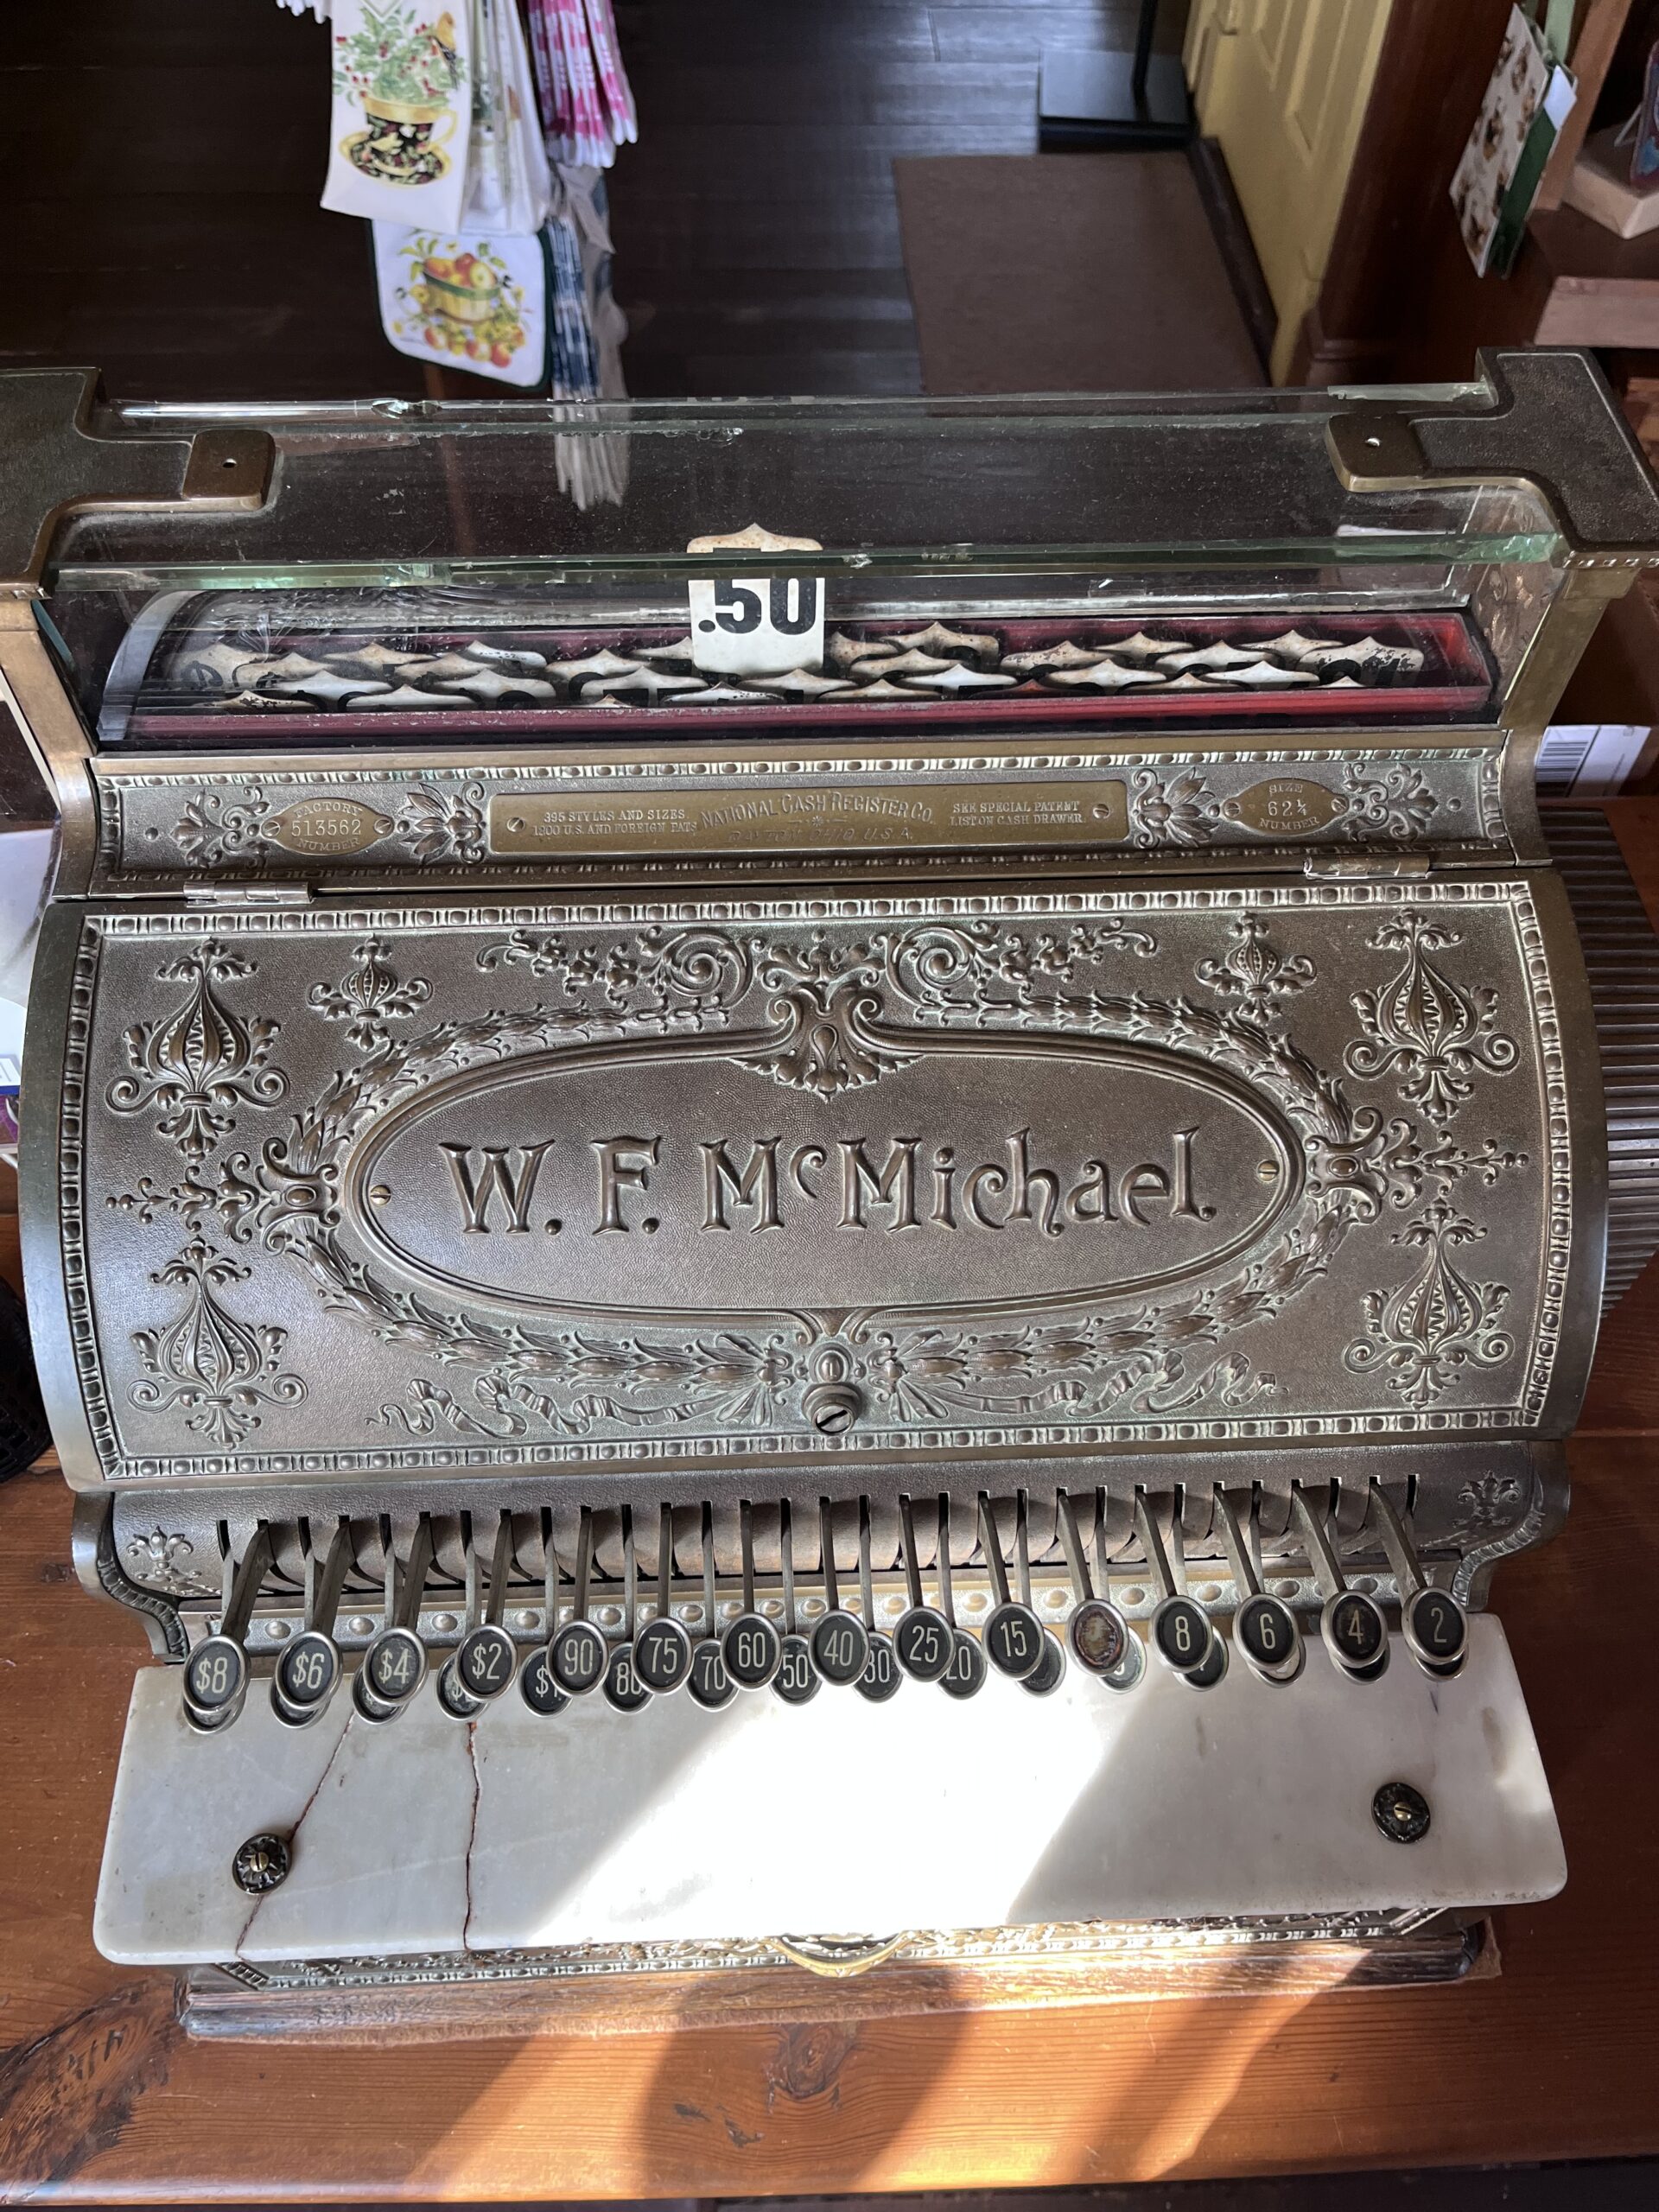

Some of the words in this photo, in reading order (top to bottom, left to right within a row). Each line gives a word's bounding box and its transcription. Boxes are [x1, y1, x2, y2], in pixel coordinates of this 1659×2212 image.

[698, 577, 817, 636] .50
[1268, 782, 1304, 794] SIZE
[294, 801, 363, 818] FACTORY
[569, 810, 614, 822] STYLES
[619, 809, 643, 822] AND
[700, 798, 779, 830] NATIONAL
[781, 793, 826, 813] CASH
[830, 791, 909, 818] REGISTER
[953, 803, 977, 814] SEE
[980, 801, 1031, 813] SPECIAL
[1034, 800, 1080, 812] PATENT
[996, 815, 1030, 825] CASH
[1260, 815, 1320, 830] NUMBER
[291, 819, 361, 836] 513562
[297, 837, 361, 852] NUMBER
[532, 825, 560, 836] 1200
[588, 823, 612, 835] AND
[614, 823, 665, 834] FOREIGN
[438, 1138, 562, 1236] W.
[589, 1135, 663, 1236] F.
[697, 1125, 1217, 1238] McMichael
[1001, 1620, 1027, 1658] 15
[1174, 1615, 1192, 1652] 8
[1259, 1612, 1276, 1649] 6
[1348, 1609, 1363, 1645] 4
[1431, 1607, 1447, 1643] 2
[472, 1643, 502, 1681] $2
[564, 1638, 594, 1676] 90
[649, 1637, 678, 1675] 75
[737, 1631, 766, 1669] 60
[823, 1629, 854, 1668] 40
[909, 1624, 939, 1664] 25
[195, 1656, 228, 1694] $8
[292, 1650, 325, 1690] $6
[378, 1648, 410, 1685] $4
[616, 1662, 642, 1695] 80
[701, 1656, 727, 1691] 70
[782, 1654, 809, 1689] 50
[864, 1649, 891, 1684] 30
